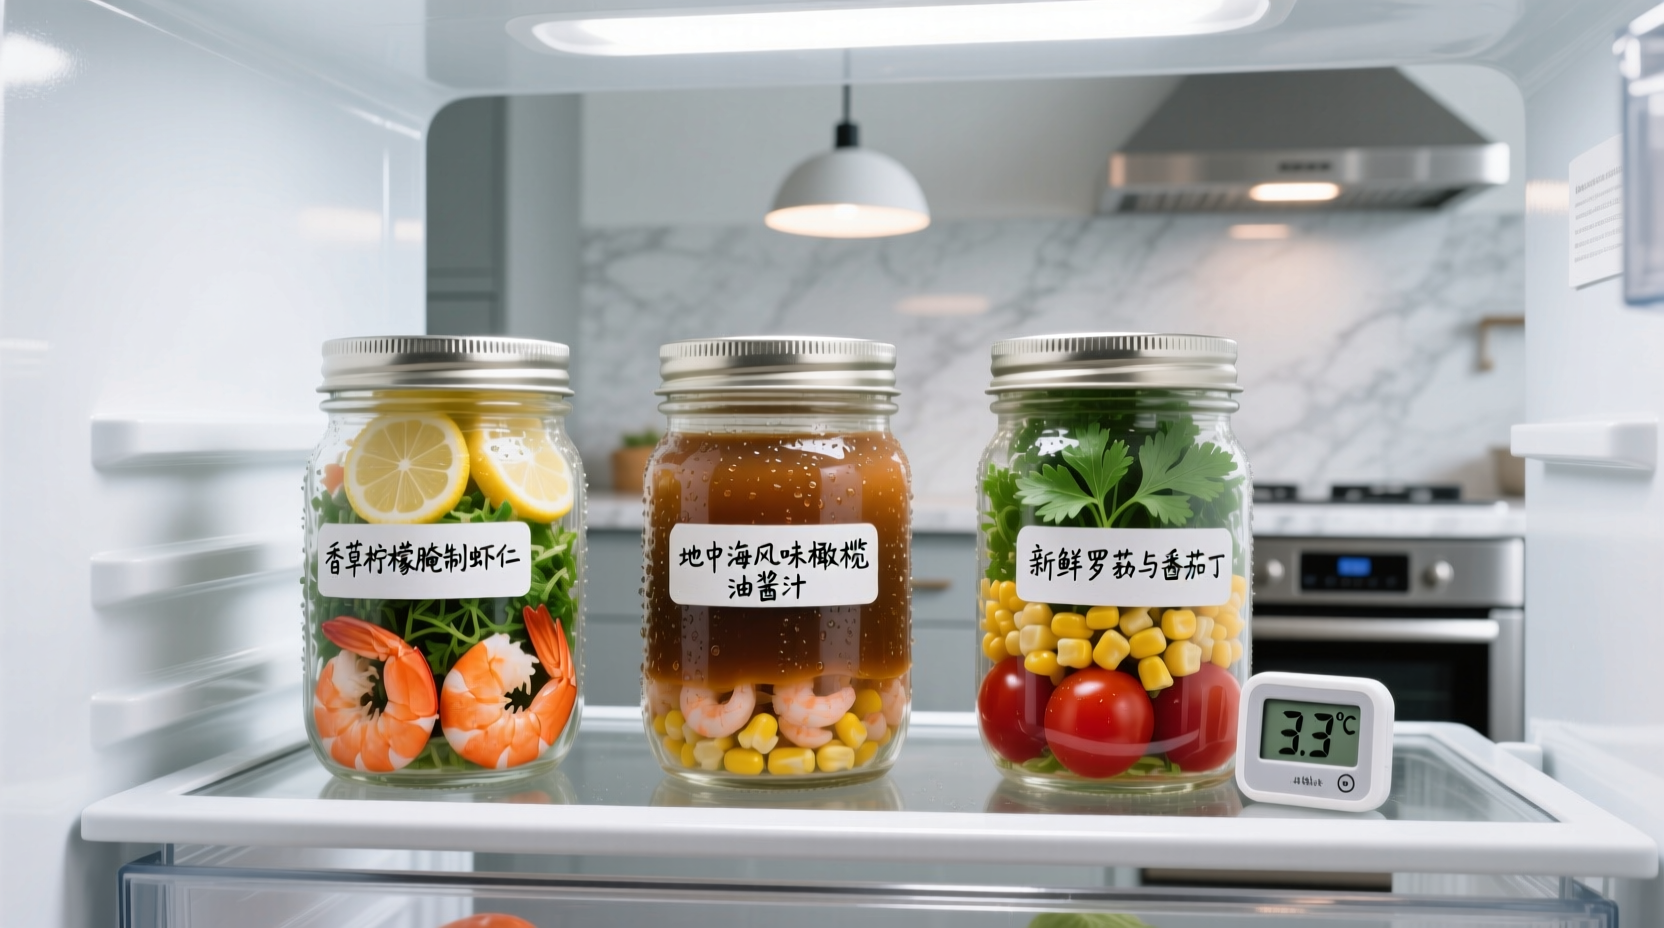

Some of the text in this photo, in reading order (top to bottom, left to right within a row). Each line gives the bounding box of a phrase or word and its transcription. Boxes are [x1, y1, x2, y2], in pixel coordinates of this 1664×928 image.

[325, 539, 521, 578] 香草柠檬腌制虾仁
[678, 537, 870, 574] 地中海风味橄榄
[727, 569, 807, 602] 油酱汁
